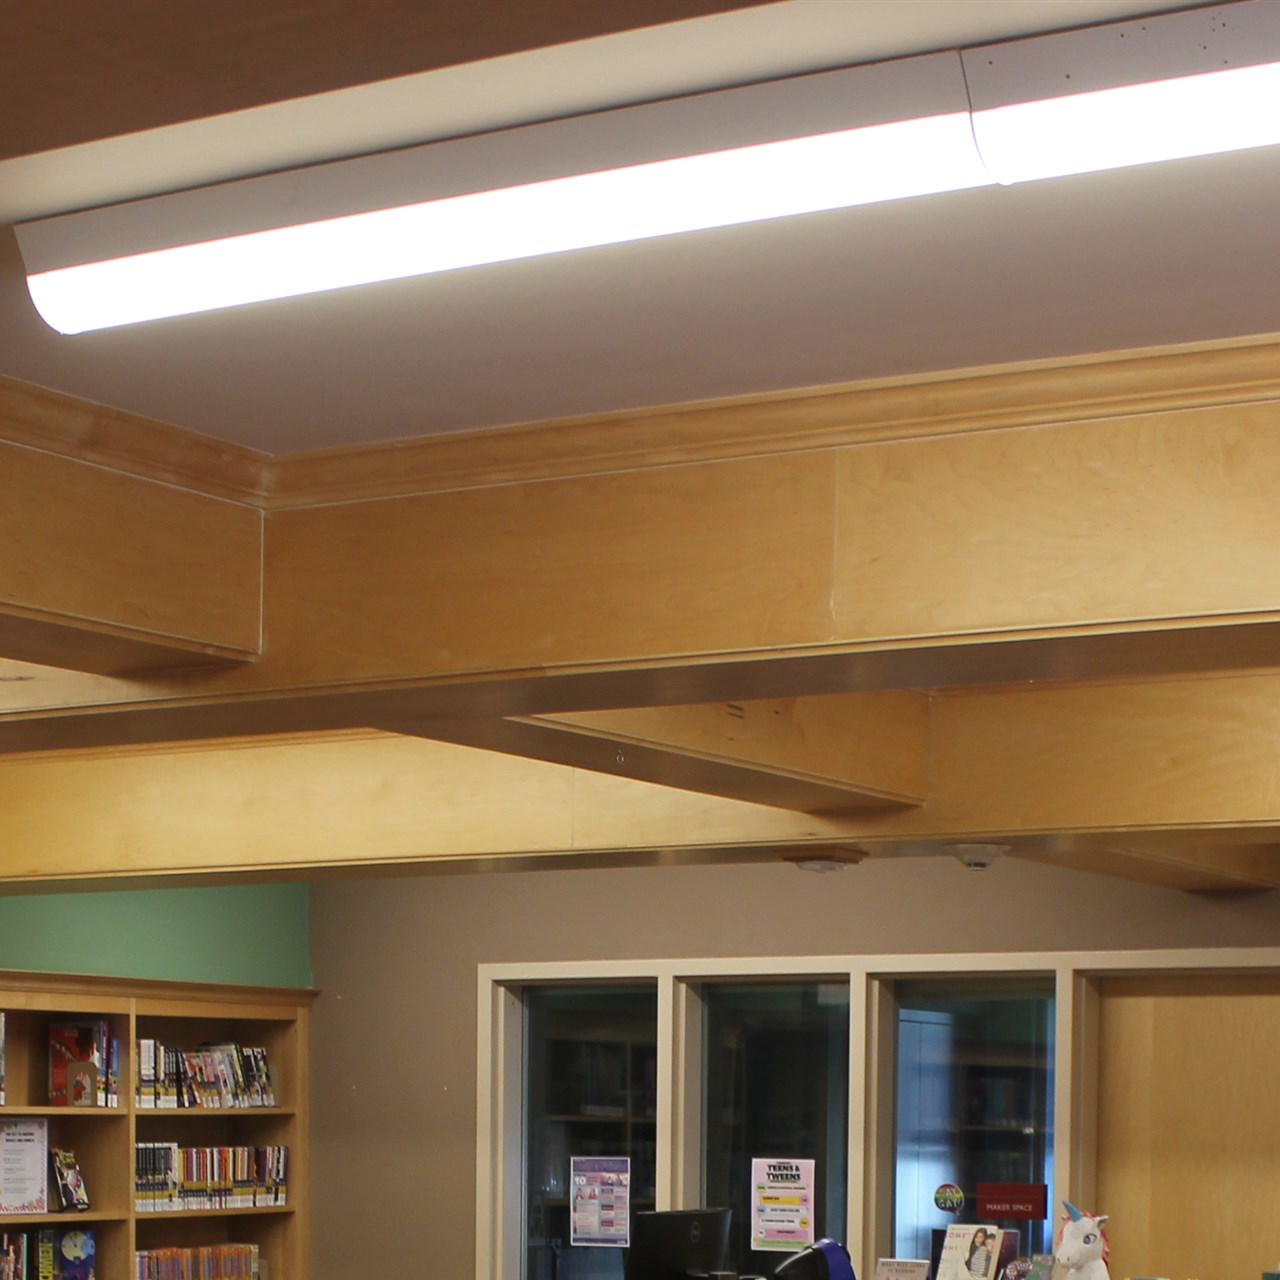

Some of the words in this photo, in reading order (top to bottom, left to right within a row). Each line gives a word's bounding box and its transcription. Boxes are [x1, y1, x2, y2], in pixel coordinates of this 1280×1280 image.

[767, 1164, 794, 1173] TEENS
[766, 1172, 801, 1181] TWEENS
[986, 1203, 1010, 1212] MAKER
[1011, 1204, 1033, 1212] SPACE
